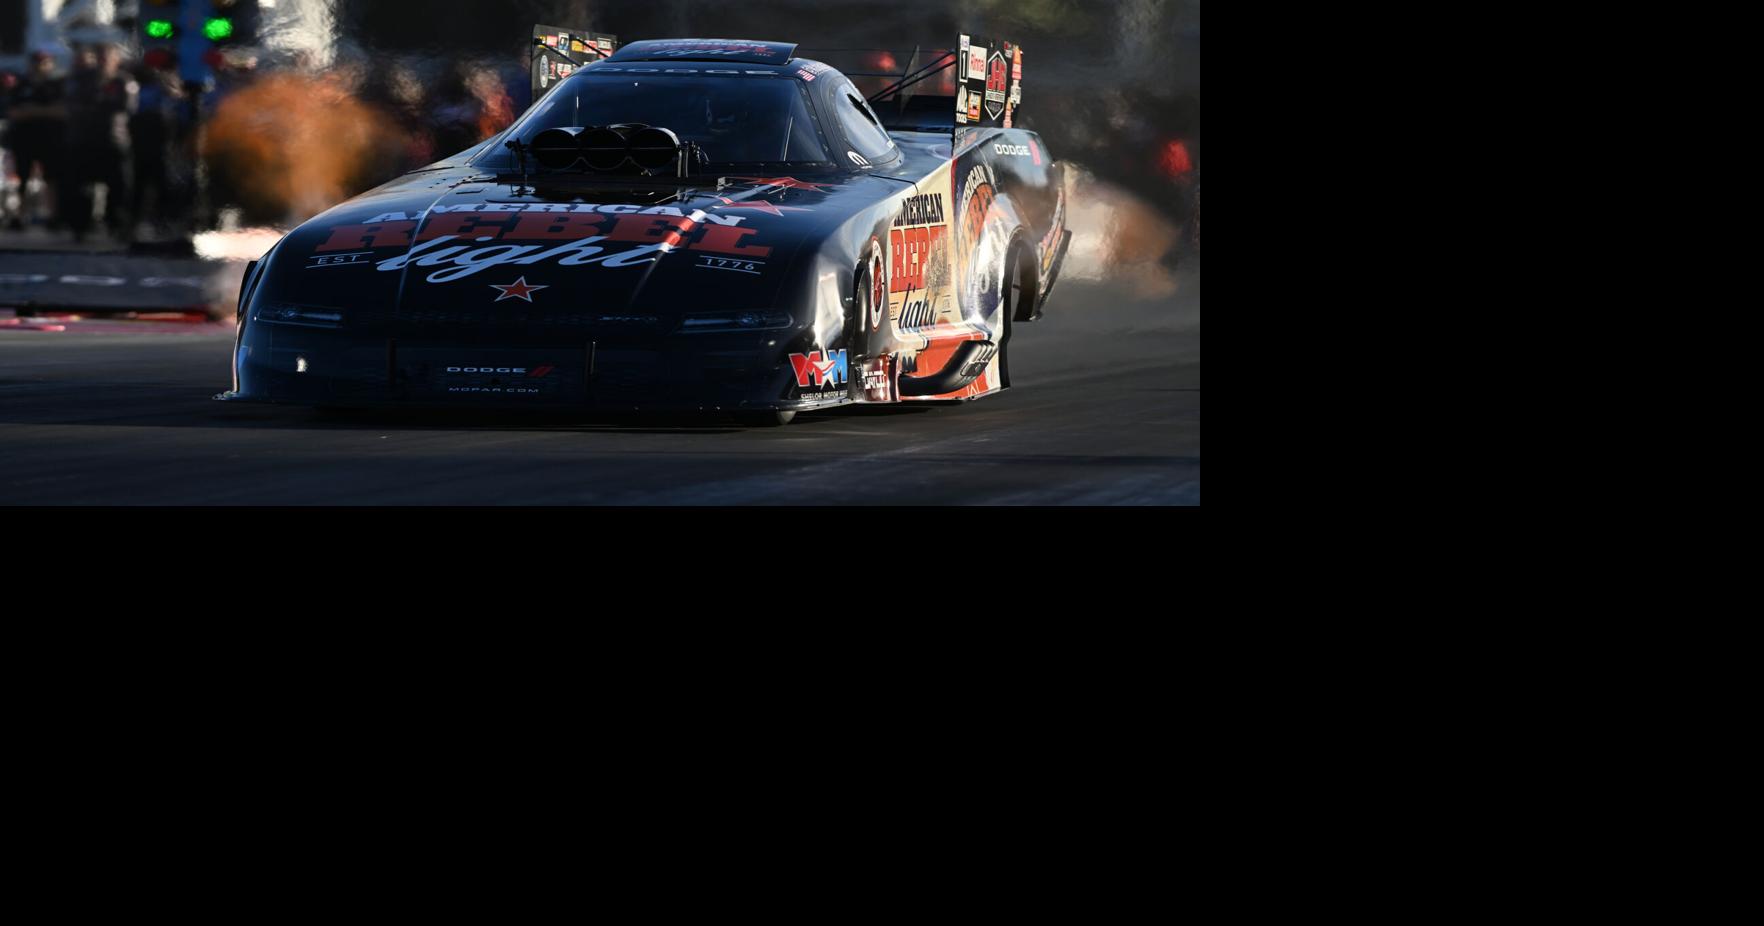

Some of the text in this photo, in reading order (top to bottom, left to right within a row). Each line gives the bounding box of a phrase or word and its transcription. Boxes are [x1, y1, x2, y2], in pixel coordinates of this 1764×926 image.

[591, 66, 779, 75] DODGE
[994, 143, 1031, 156] DODGE
[362, 203, 747, 227] AMERICAN
[893, 193, 944, 227] AMERICAN
[314, 210, 774, 257] REBEL
[316, 253, 361, 266] EST
[375, 235, 680, 284] light
[704, 257, 756, 272] 1776
[446, 366, 527, 374] DODGE
[448, 386, 540, 394] MOPAR.COM
